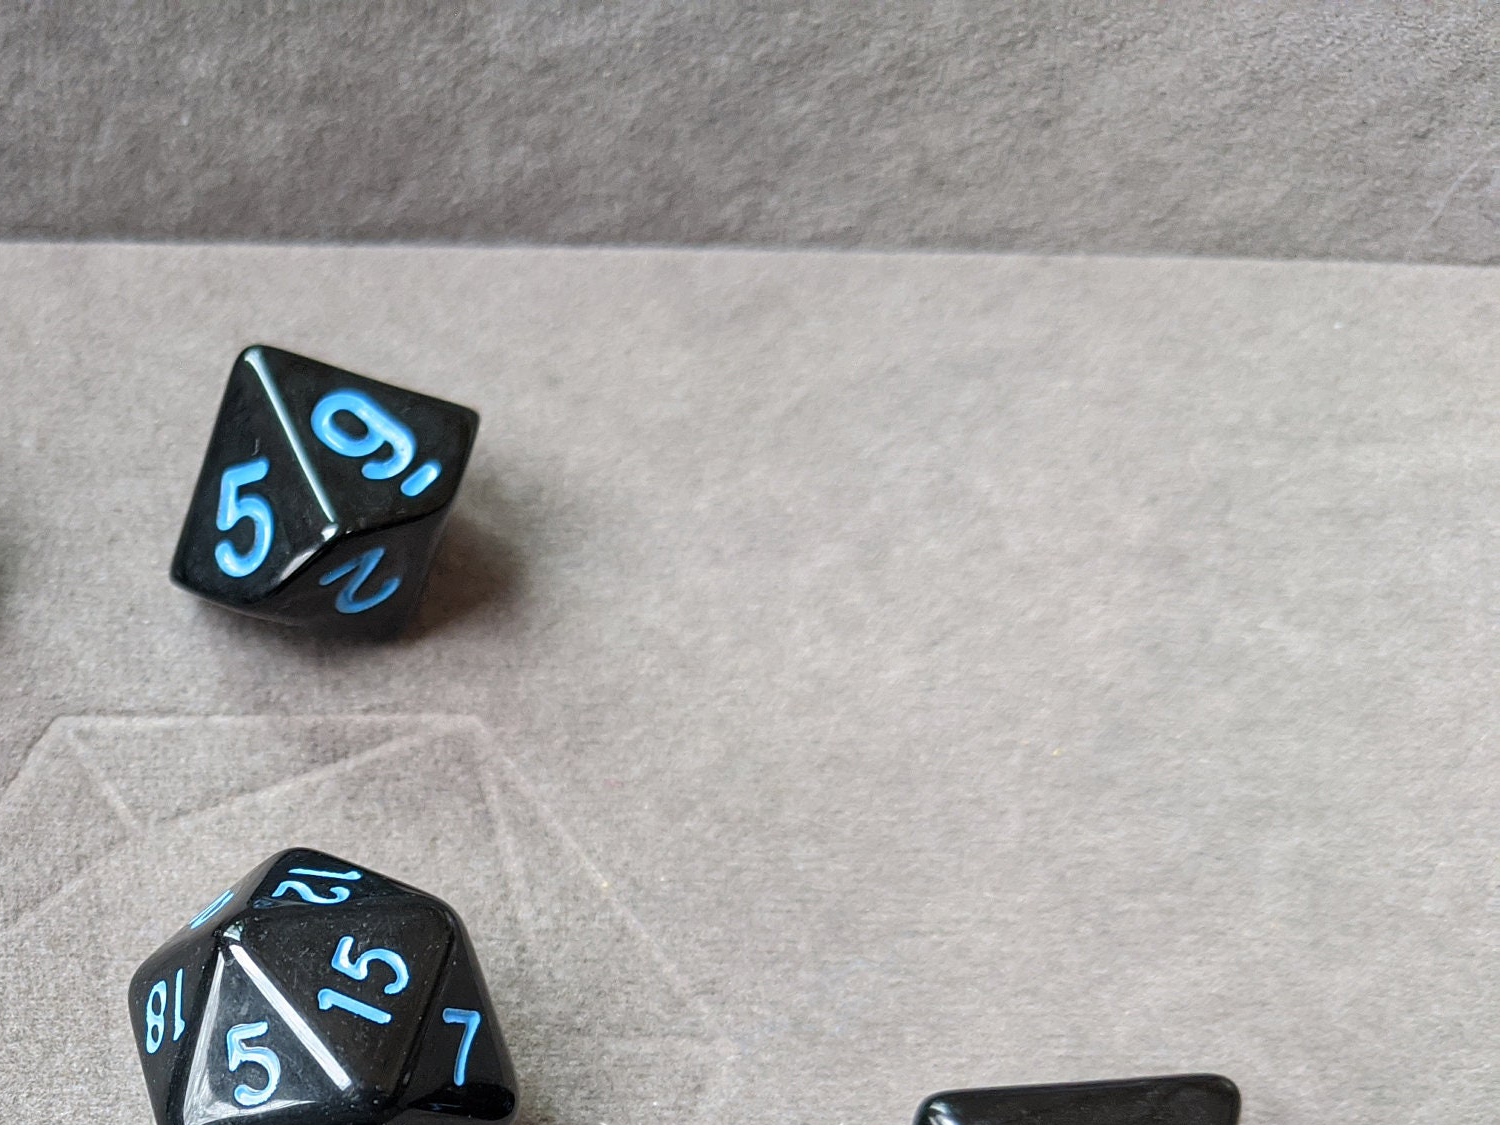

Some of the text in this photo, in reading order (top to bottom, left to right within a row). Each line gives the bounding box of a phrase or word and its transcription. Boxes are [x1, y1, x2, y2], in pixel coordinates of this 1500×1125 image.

[214, 455, 275, 579] 5
[270, 867, 364, 906] 12
[145, 967, 187, 1056] 18
[317, 935, 411, 1026] 15
[226, 1020, 283, 1108] 5
[442, 1007, 483, 1087] 7
